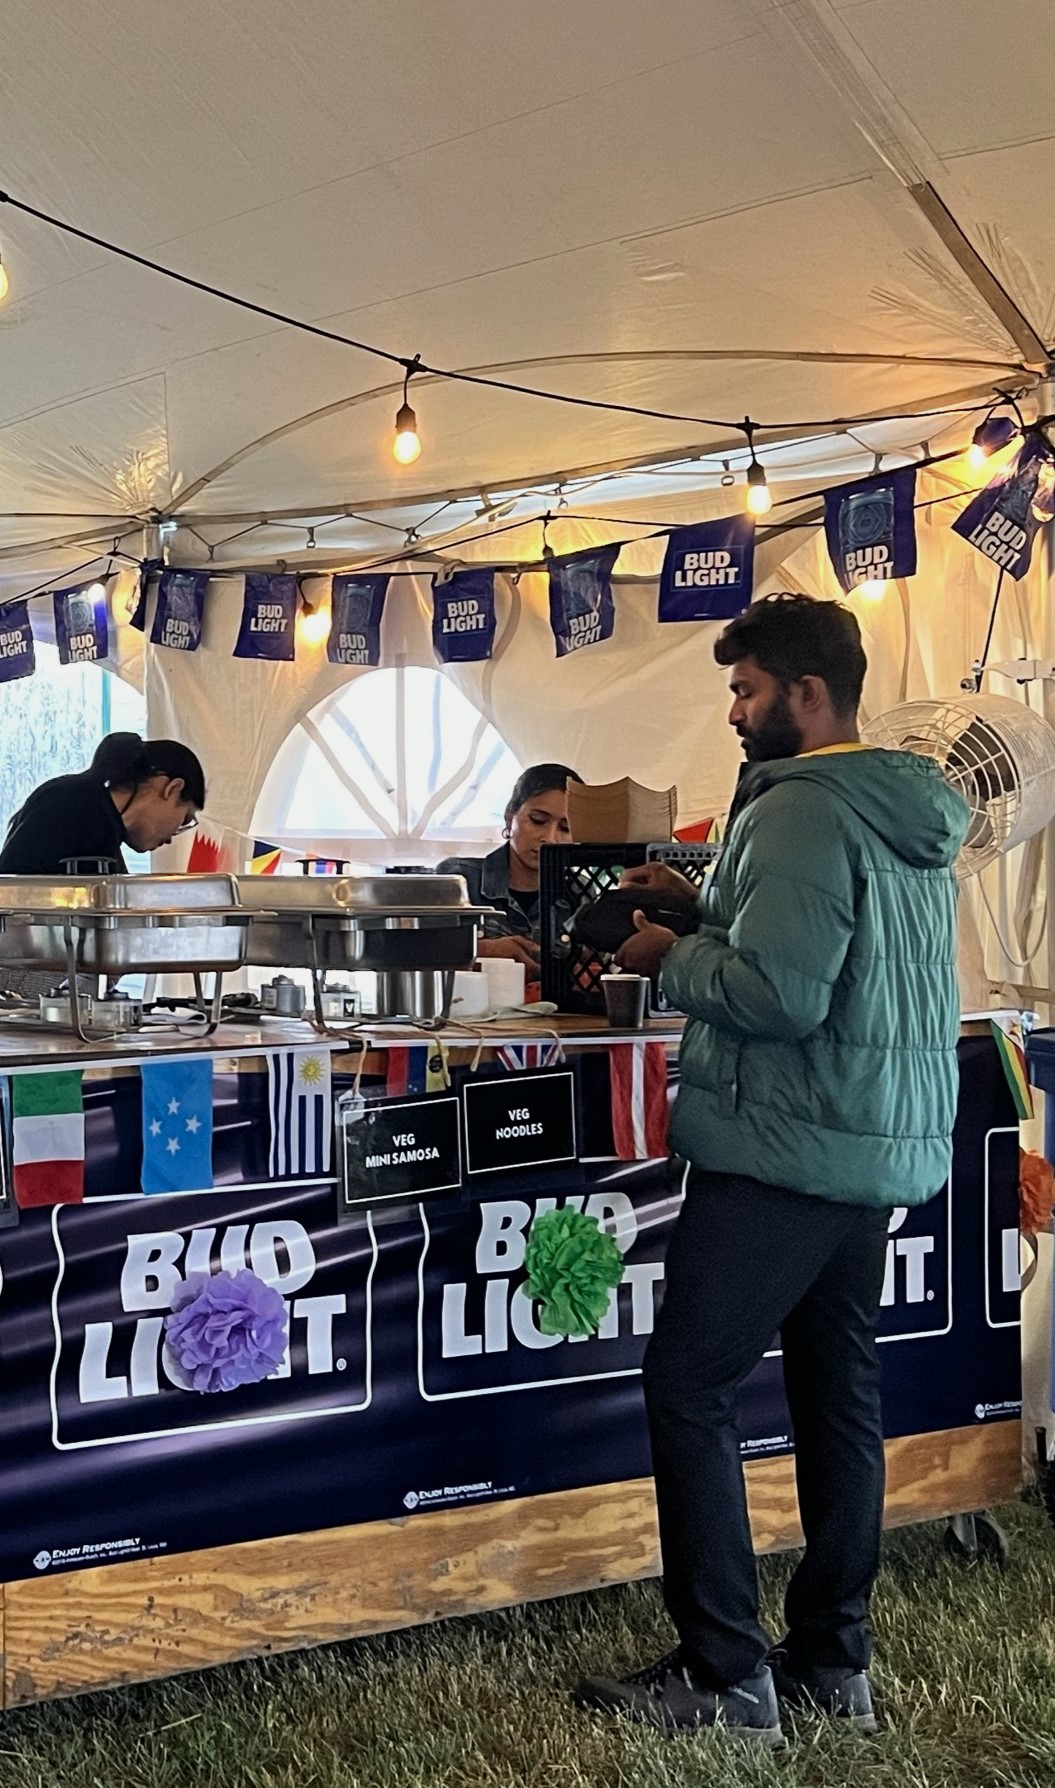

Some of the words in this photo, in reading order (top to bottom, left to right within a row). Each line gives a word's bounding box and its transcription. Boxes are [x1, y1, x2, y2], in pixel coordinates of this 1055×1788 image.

[986, 511, 1026, 550] BUD
[968, 524, 1021, 570] LIGHT
[684, 551, 731, 570] BUD
[846, 546, 888, 570] BUD
[674, 568, 739, 588] LIGHT
[258, 604, 282, 618] BUD
[447, 600, 478, 617] BUD
[166, 619, 188, 636] BUD
[250, 618, 287, 632] LIGHT
[442, 614, 486, 633] LIGHT
[570, 612, 600, 635] BUD
[0, 630, 22, 644] BUD
[70, 634, 94, 649] BUD
[161, 631, 190, 648] LIGHT
[340, 634, 366, 649] BUD
[69, 646, 98, 662] LIGHT
[336, 648, 368, 664] LIGHT
[508, 1108, 530, 1121] VEG
[393, 1133, 416, 1147] VEG
[496, 1123, 544, 1140] NOODLES
[365, 1154, 391, 1168] MINI
[392, 1147, 439, 1164] SAMOSA
